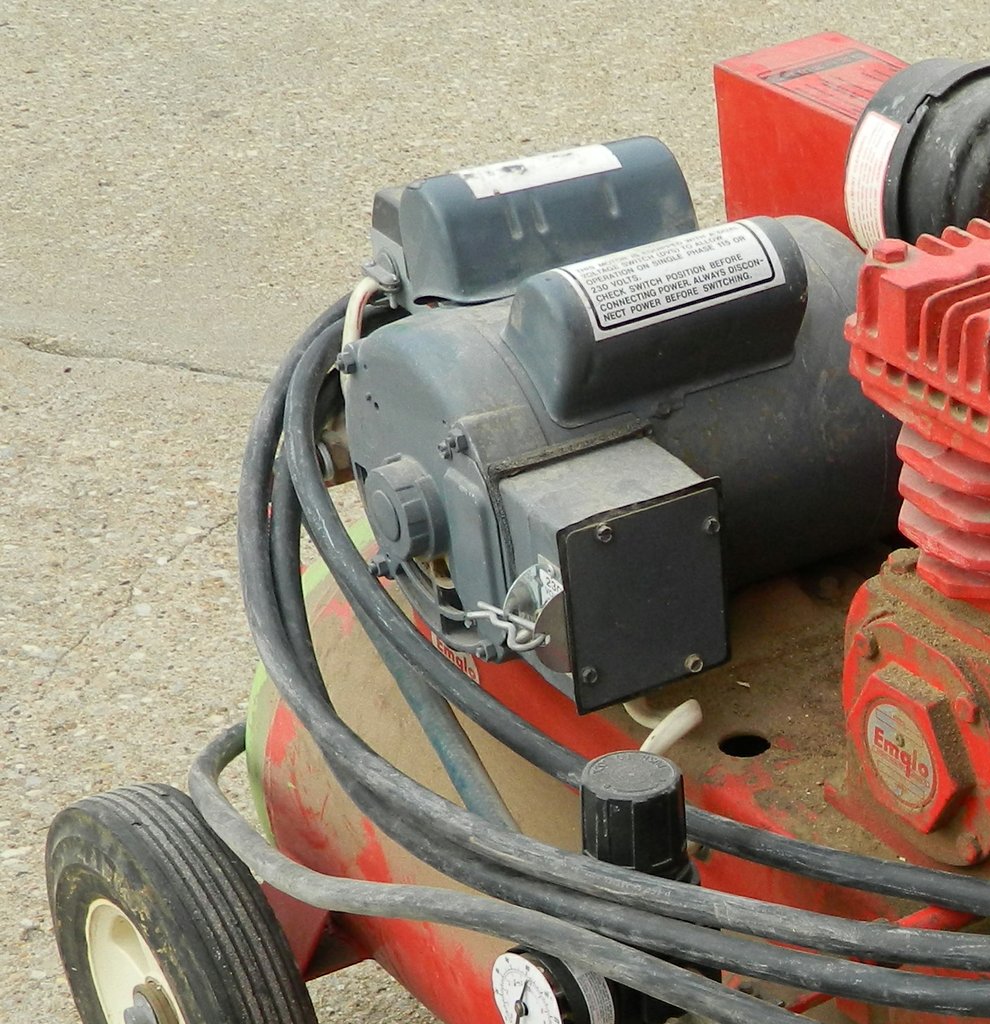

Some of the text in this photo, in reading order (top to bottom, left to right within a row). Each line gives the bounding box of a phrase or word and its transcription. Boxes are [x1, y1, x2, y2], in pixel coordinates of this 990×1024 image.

[582, 235, 723, 279] VOLTAGE SWITCH (DVS) TO ALLOW
[585, 235, 746, 286] OPERATION ON SINGLE PHASE 115 OR
[595, 253, 743, 303] CHECK SWITCH POSITION BEFORE
[591, 274, 642, 295] 230 VOLTS.
[599, 258, 765, 313] CONNECTING POWER. ALWAYS DISCON-
[603, 272, 753, 322] NECT POWER BEFORE SWITCHING.
[873, 727, 929, 778] Emglo
